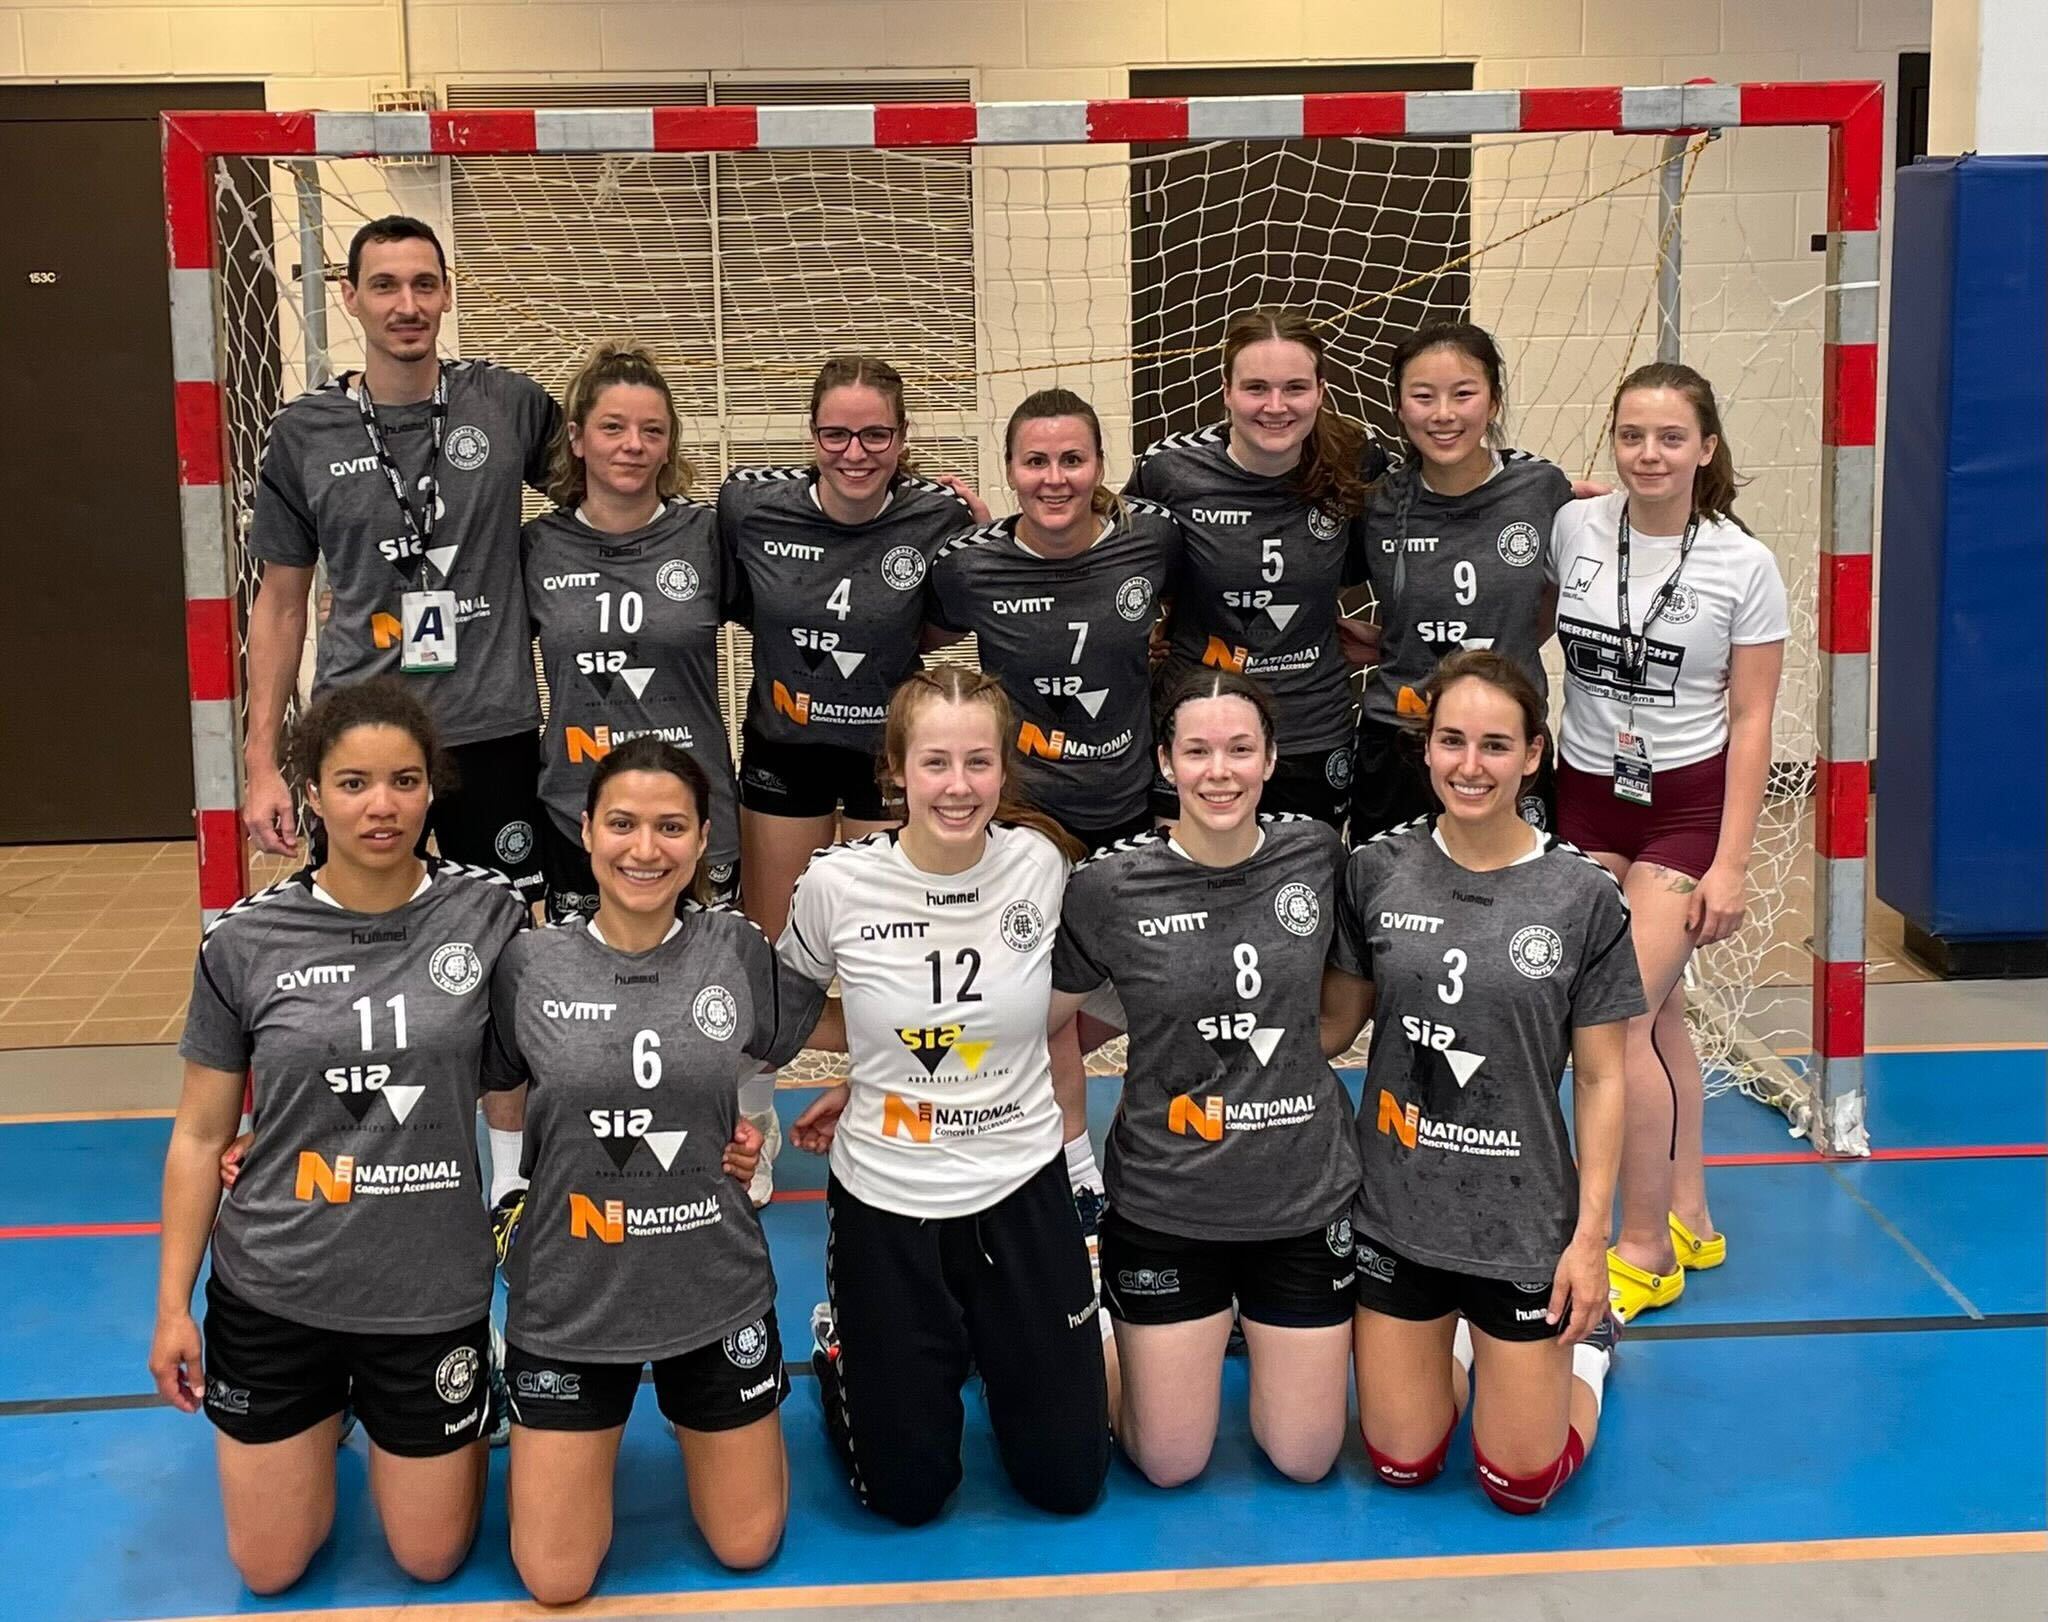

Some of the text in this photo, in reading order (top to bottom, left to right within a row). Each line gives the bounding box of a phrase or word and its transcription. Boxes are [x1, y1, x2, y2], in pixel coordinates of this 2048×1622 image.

[29, 272, 56, 283] 153C
[330, 455, 378, 476] OVM
[1261, 538, 1284, 583] 5
[1453, 560, 1477, 606] 9
[595, 591, 644, 634] 10
[826, 578, 851, 621] 4
[1223, 590, 1273, 609] sia
[411, 606, 444, 643] A
[1417, 620, 1468, 643] sia
[791, 627, 840, 651] sia
[1067, 621, 1089, 665] 7
[576, 650, 628, 675] sia
[1033, 676, 1083, 696] sia
[1064, 729, 1134, 757] NATIONAL
[926, 888, 979, 906] hummel
[1452, 889, 1494, 906] hummel
[351, 927, 407, 945] hummel
[615, 972, 660, 986] hummel
[924, 947, 983, 1005] 12
[1233, 942, 1262, 1000] 8
[1437, 947, 1468, 1005] 3
[352, 993, 408, 1051] 11
[1197, 1012, 1257, 1040] sia
[1402, 1014, 1456, 1051] sia
[900, 1023, 963, 1050] sia
[632, 1028, 662, 1090] 6
[324, 1063, 391, 1093] sia
[935, 1101, 1021, 1126] NATIONAL
[1225, 1095, 1316, 1122] NATIONAL
[589, 1108, 653, 1138] sia
[935, 1111, 1025, 1137] Concrete Accessories
[1225, 1119, 1266, 1131] Concrete
[1419, 1117, 1521, 1147] NATIONAL
[1418, 1135, 1520, 1157] Concrete Accessories
[355, 1160, 461, 1184] NATIONAL
[354, 1179, 460, 1195] Concrete Accessories
[626, 1195, 720, 1226] NATIONAL
[627, 1224, 673, 1237] Concrete
[1118, 1269, 1180, 1289] CMC
[1515, 1308, 1547, 1321] humm
[516, 1370, 581, 1393] CMC
